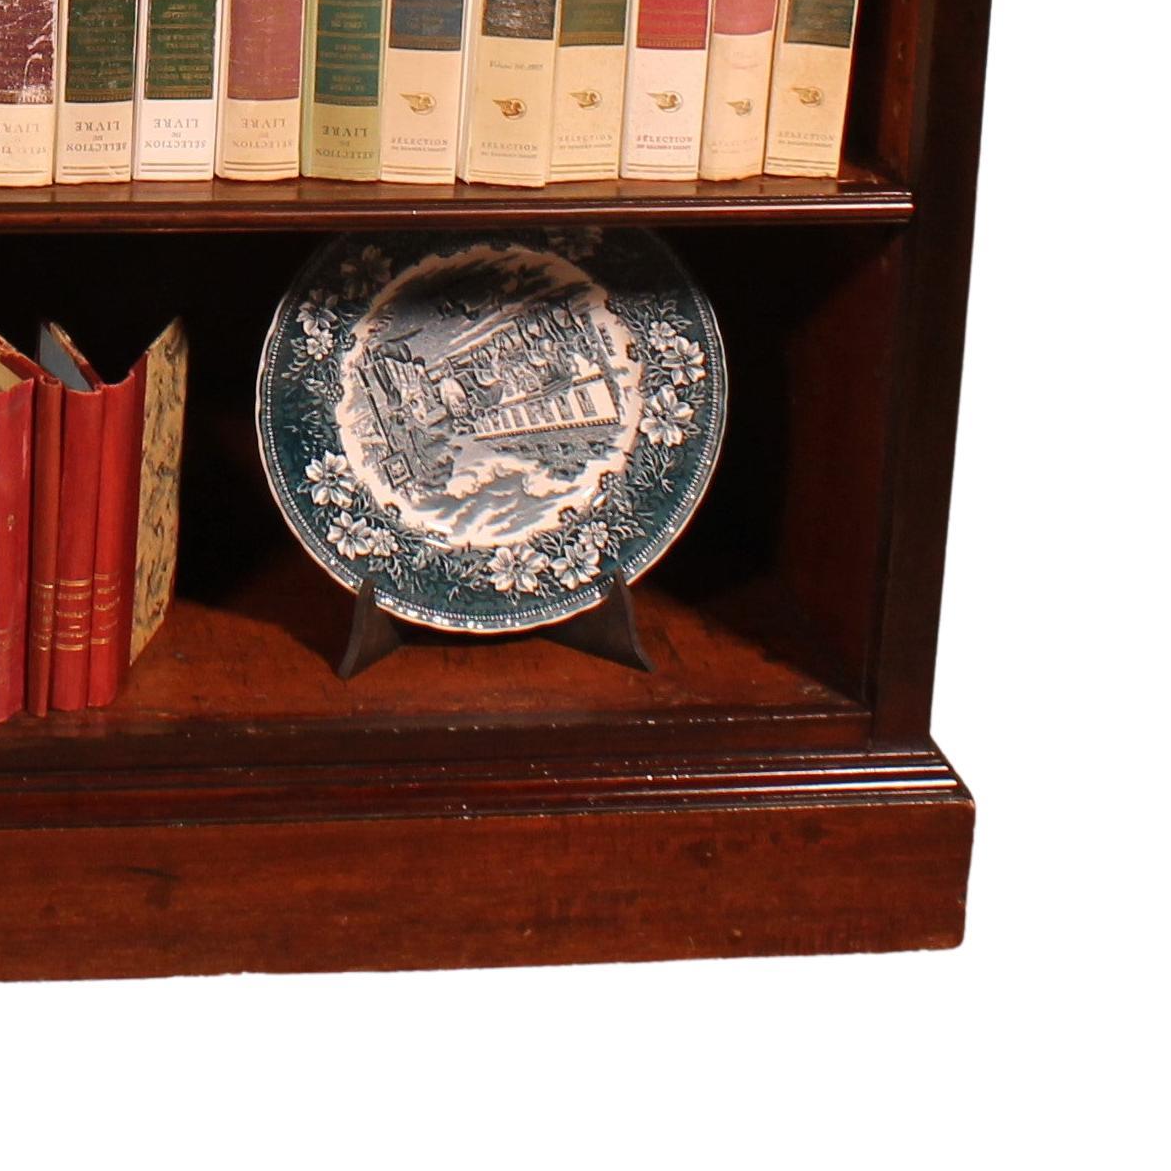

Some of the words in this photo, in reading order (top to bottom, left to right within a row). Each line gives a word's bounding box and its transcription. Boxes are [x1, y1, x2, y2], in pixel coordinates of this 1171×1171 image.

[75, 121, 120, 132] LIVRE
[153, 118, 198, 129] LIVRE
[240, 118, 285, 129] LIVRE
[322, 126, 367, 137] LIVRE
[144, 140, 207, 149] SÉLECTION
